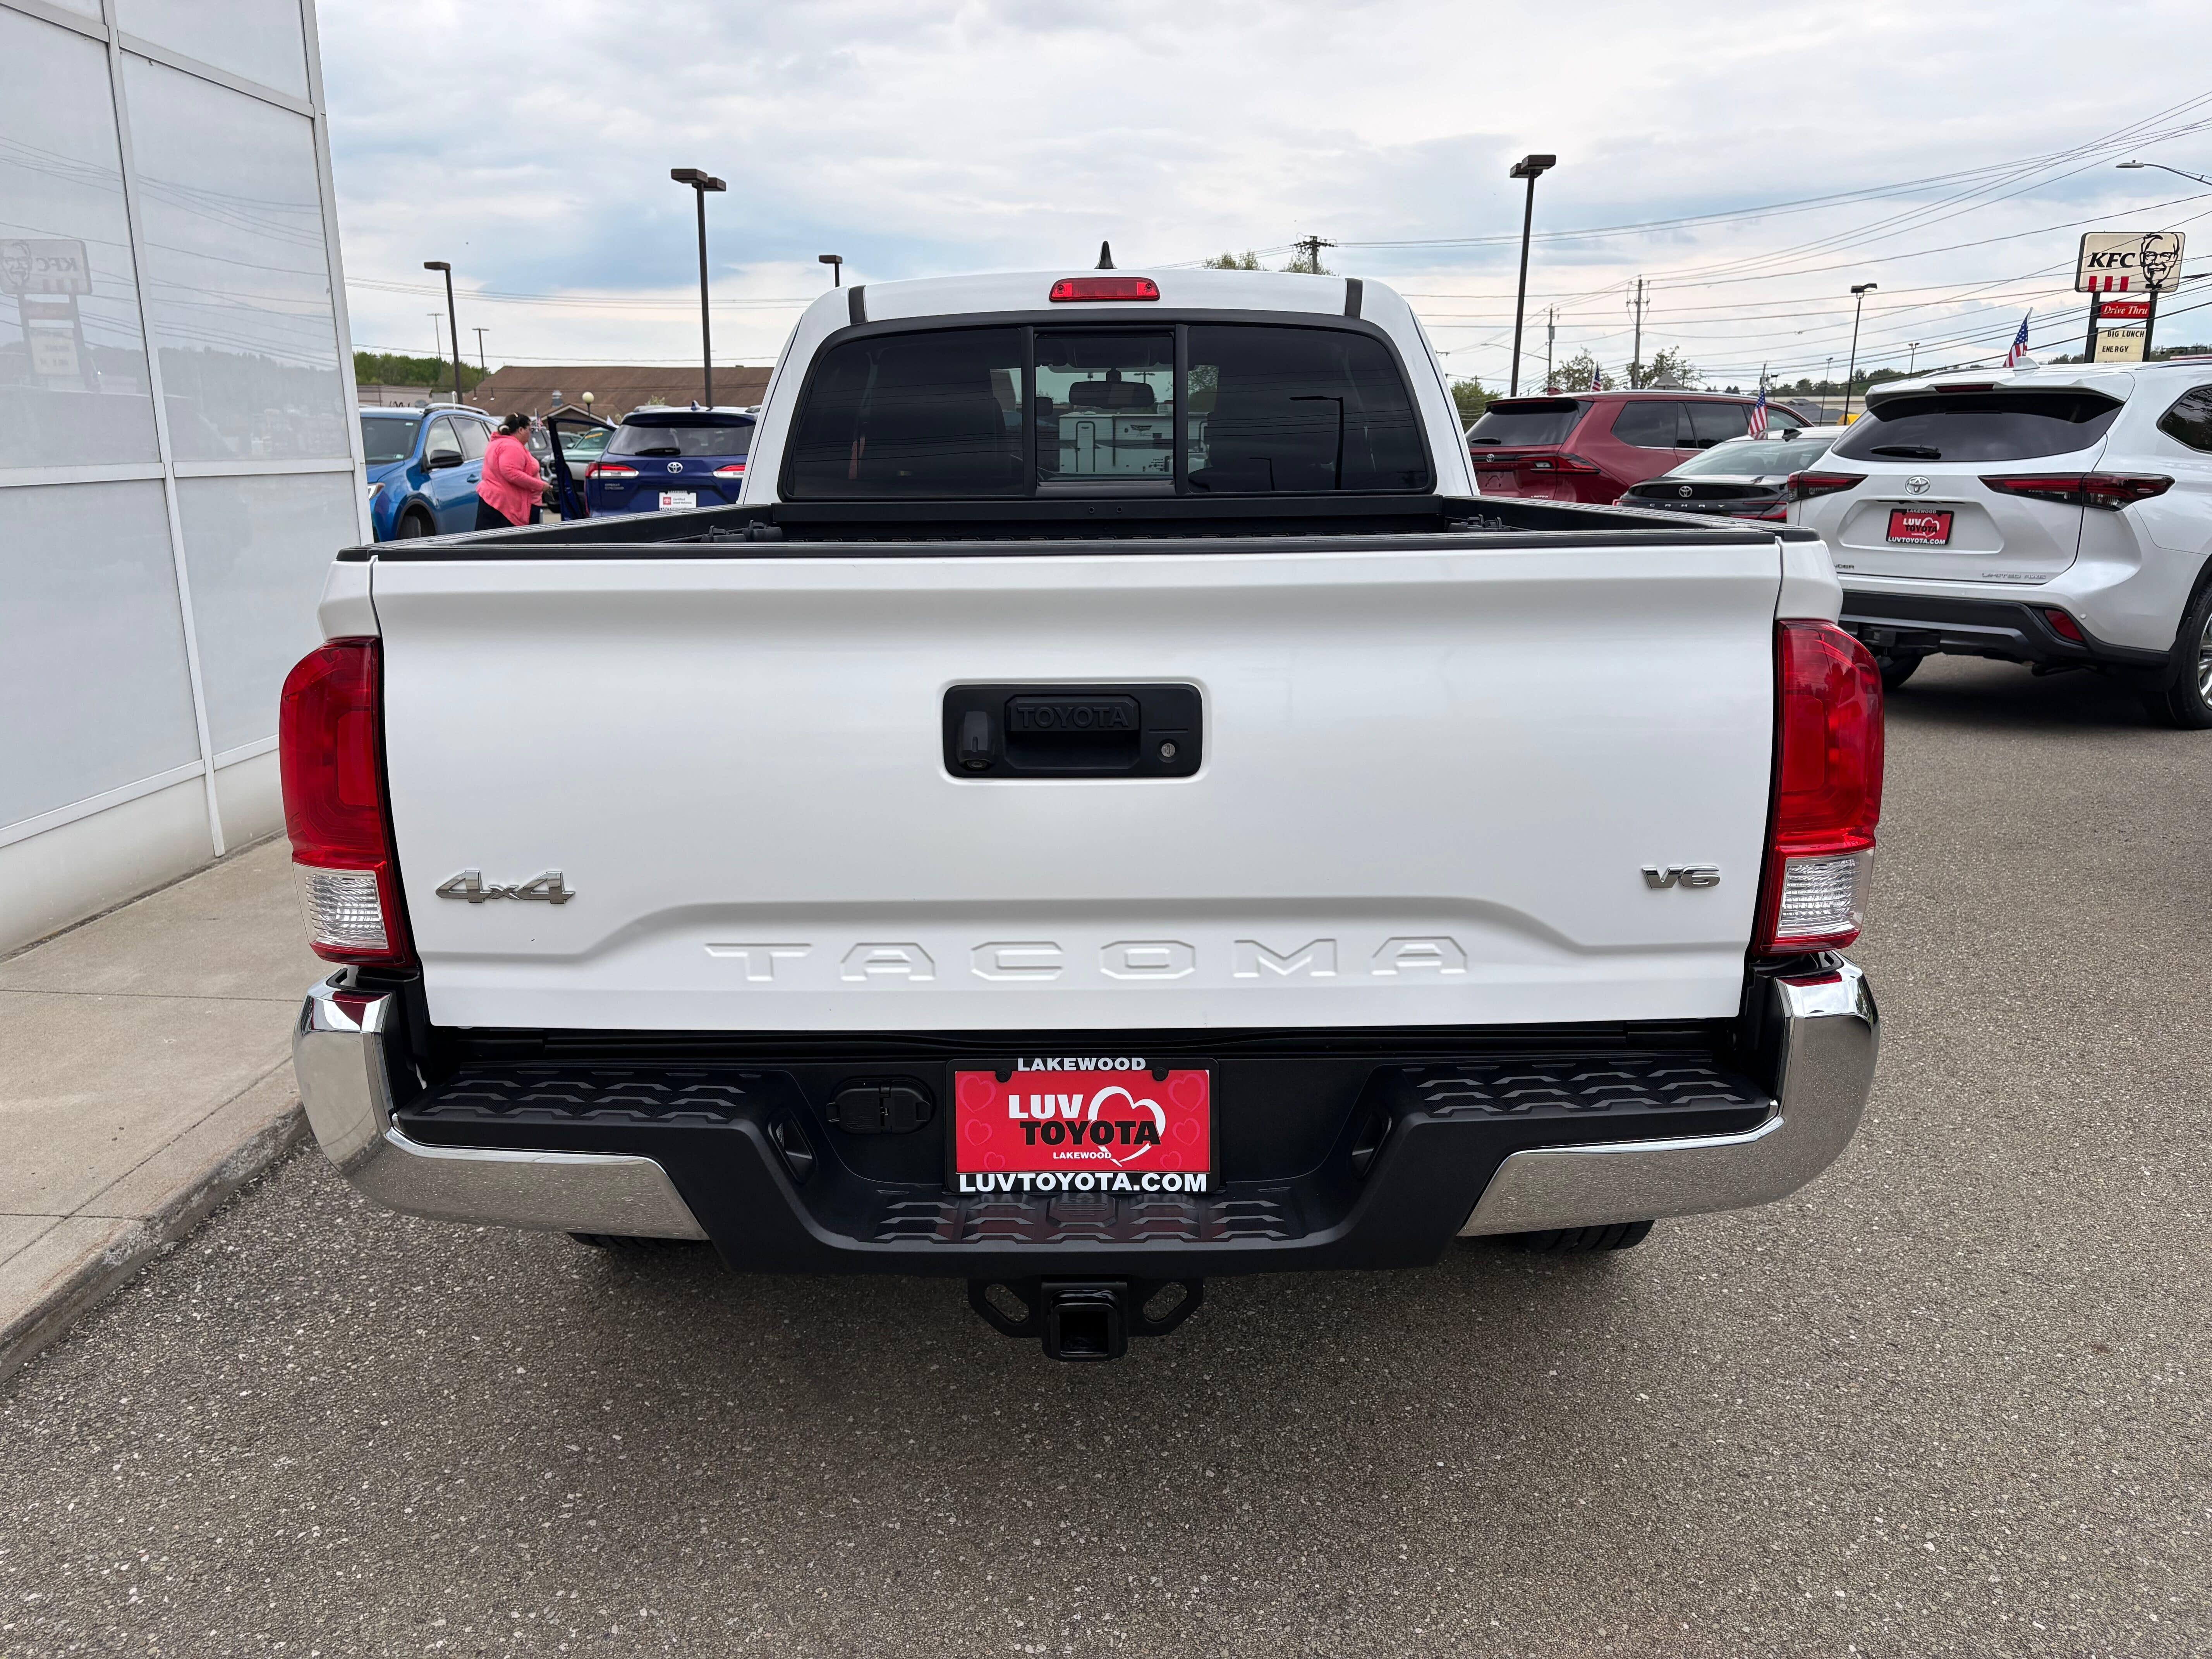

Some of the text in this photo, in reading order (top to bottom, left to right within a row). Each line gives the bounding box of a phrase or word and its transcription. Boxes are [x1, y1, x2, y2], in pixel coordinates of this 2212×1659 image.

[2087, 252, 2136, 268] KFC
[2103, 306, 2148, 314] Drive Thru
[1905, 525, 1937, 533] TOYOTA
[1888, 536, 1946, 545] LUVTOYOTA.COM
[1017, 706, 1130, 728] TOYOTA
[435, 870, 576, 904] 4x4
[1642, 866, 1720, 889] V6
[704, 935, 1469, 982] TACOMA
[1018, 1058, 1146, 1072] LAKEWOOD
[1008, 1094, 1084, 1119] LUV
[1019, 1120, 1161, 1146] TOYOTA
[959, 1172, 1207, 1192] LUVTOYOTA.COM
